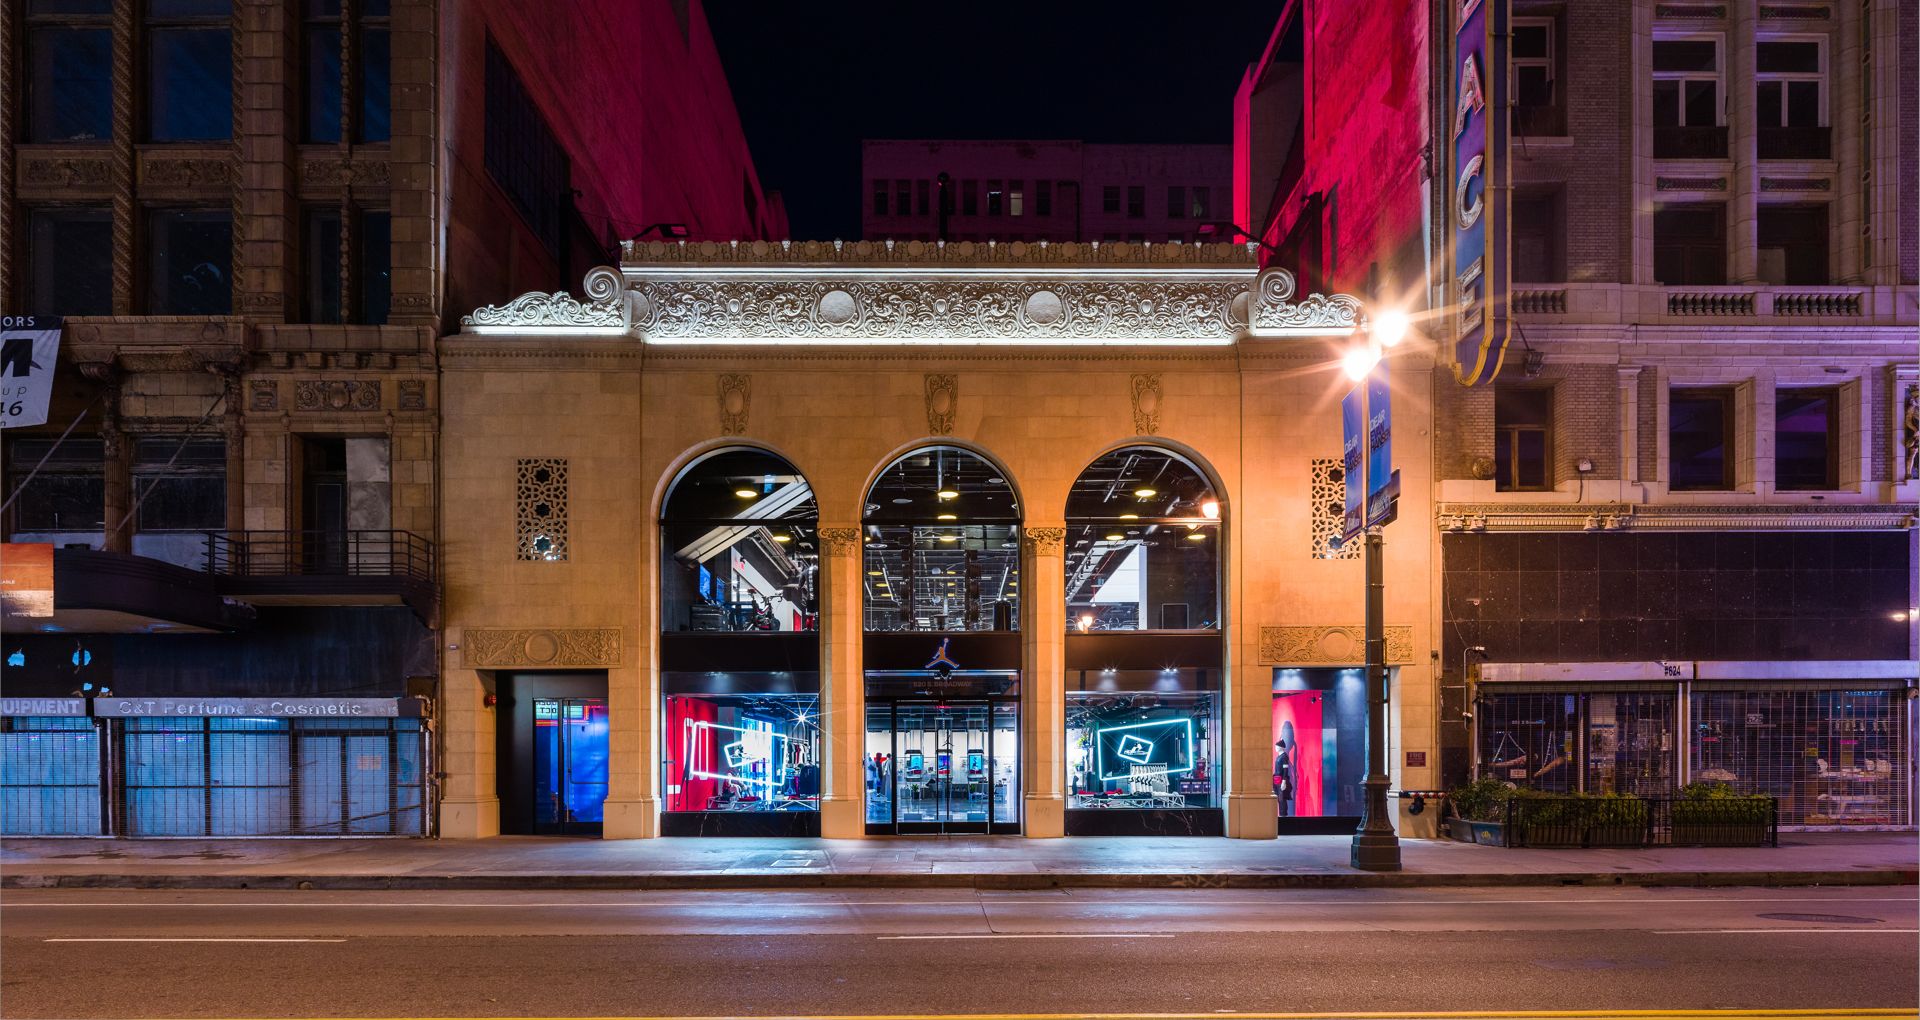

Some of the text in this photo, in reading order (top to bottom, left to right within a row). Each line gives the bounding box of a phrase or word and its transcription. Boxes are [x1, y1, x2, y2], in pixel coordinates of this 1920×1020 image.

[1369, 409, 1385, 431] DEAR
[1664, 665, 1681, 677] #624
[0, 700, 80, 715] UIPMENT
[119, 701, 157, 715] C&T
[163, 701, 246, 715] Perfume
[254, 705, 264, 715] &
[271, 701, 362, 715] Cosmetic
